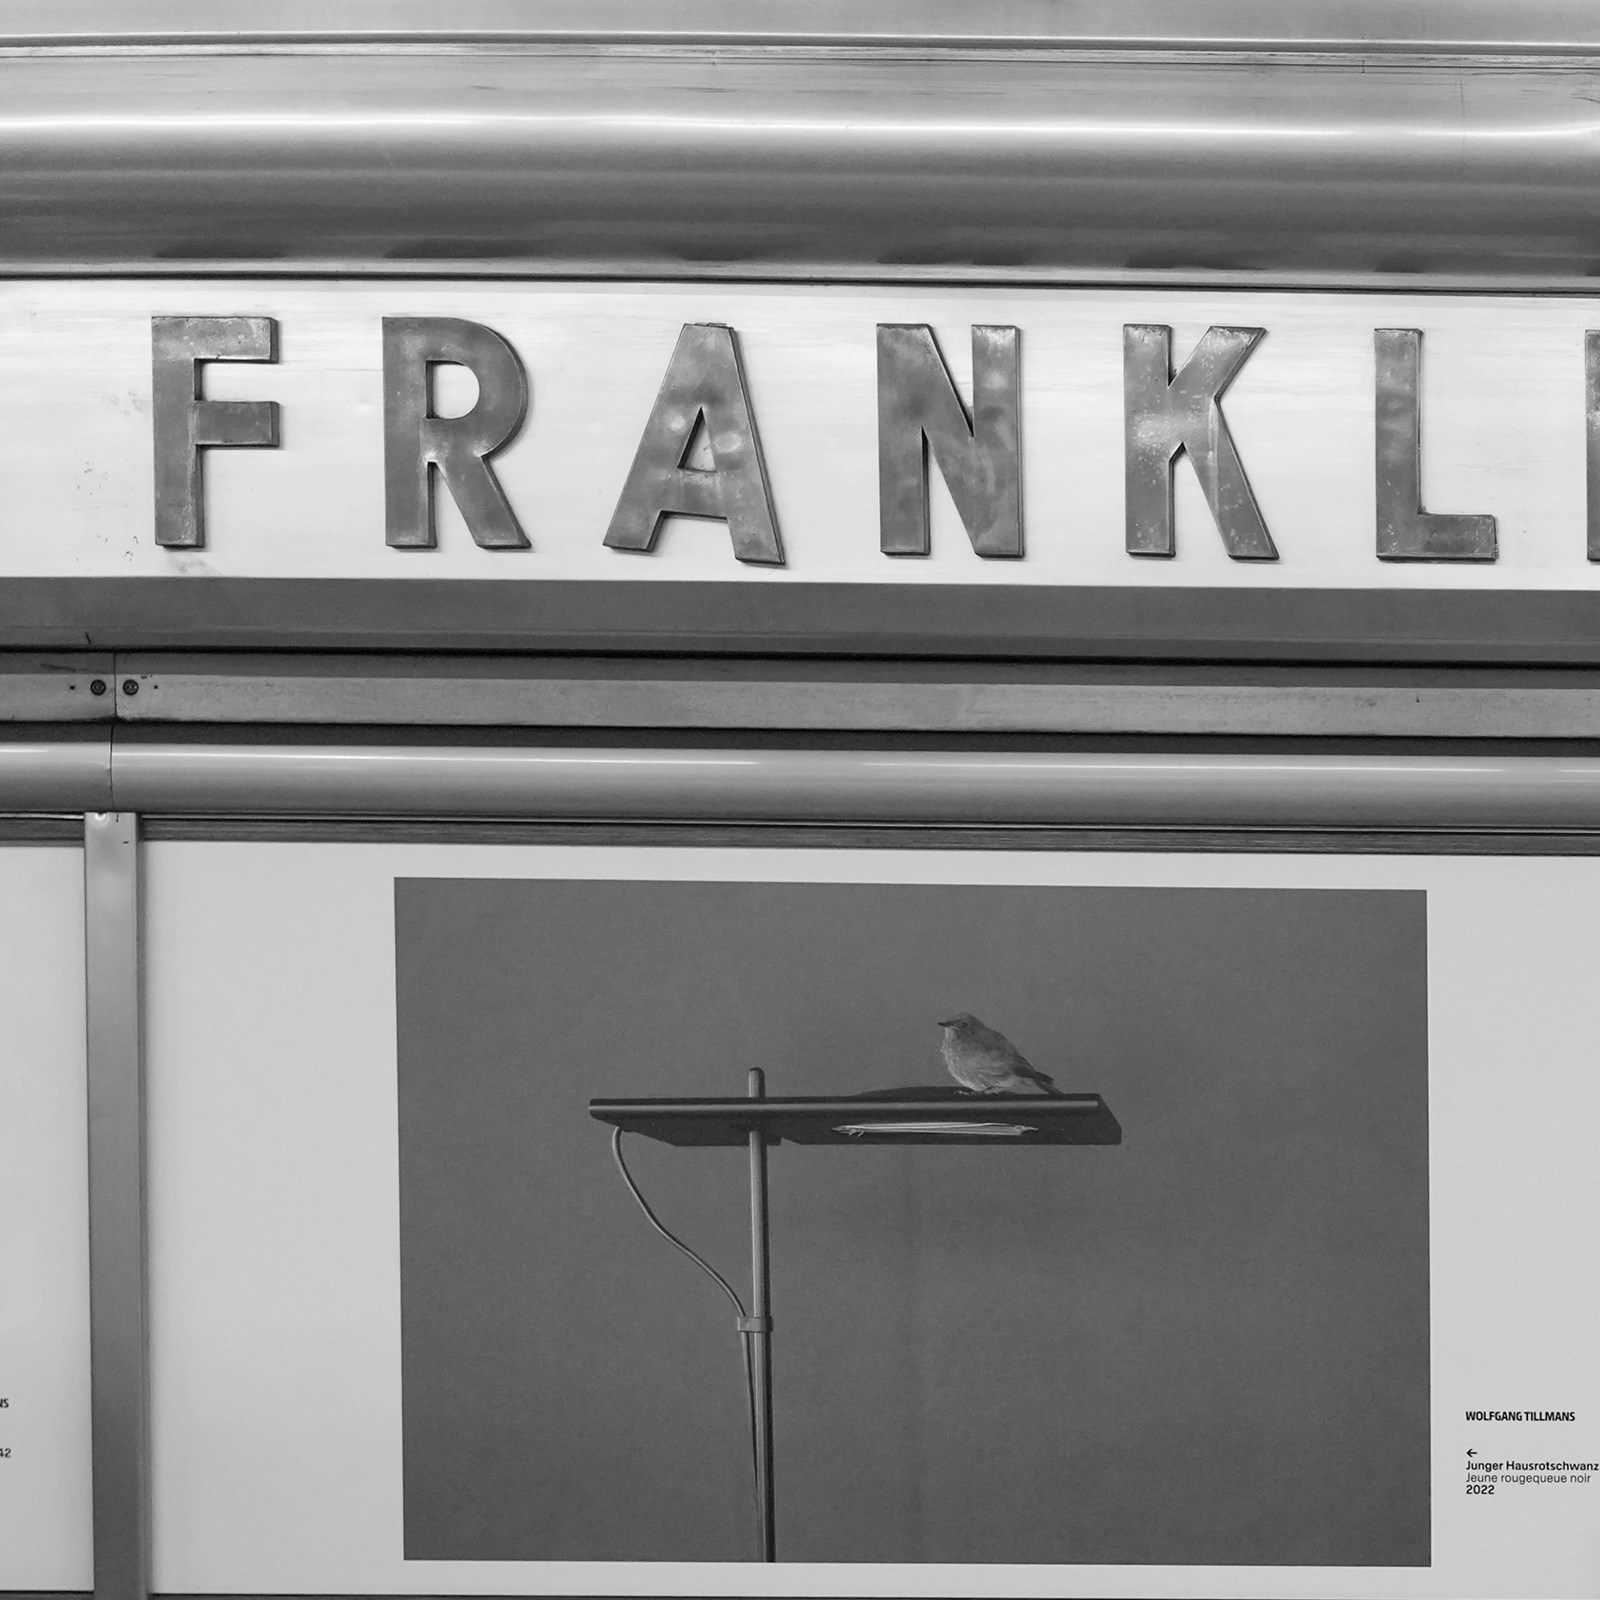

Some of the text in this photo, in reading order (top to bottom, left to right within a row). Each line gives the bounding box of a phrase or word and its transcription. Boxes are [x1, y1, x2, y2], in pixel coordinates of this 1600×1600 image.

[1466, 1411, 1575, 1421] WOLFGANG TILLMANS
[1466, 1461, 1599, 1472] Junger Hausrotschwanz
[1466, 1473, 1591, 1485] Jeune rougequeue noir
[1466, 1485, 1494, 1494] 2022
